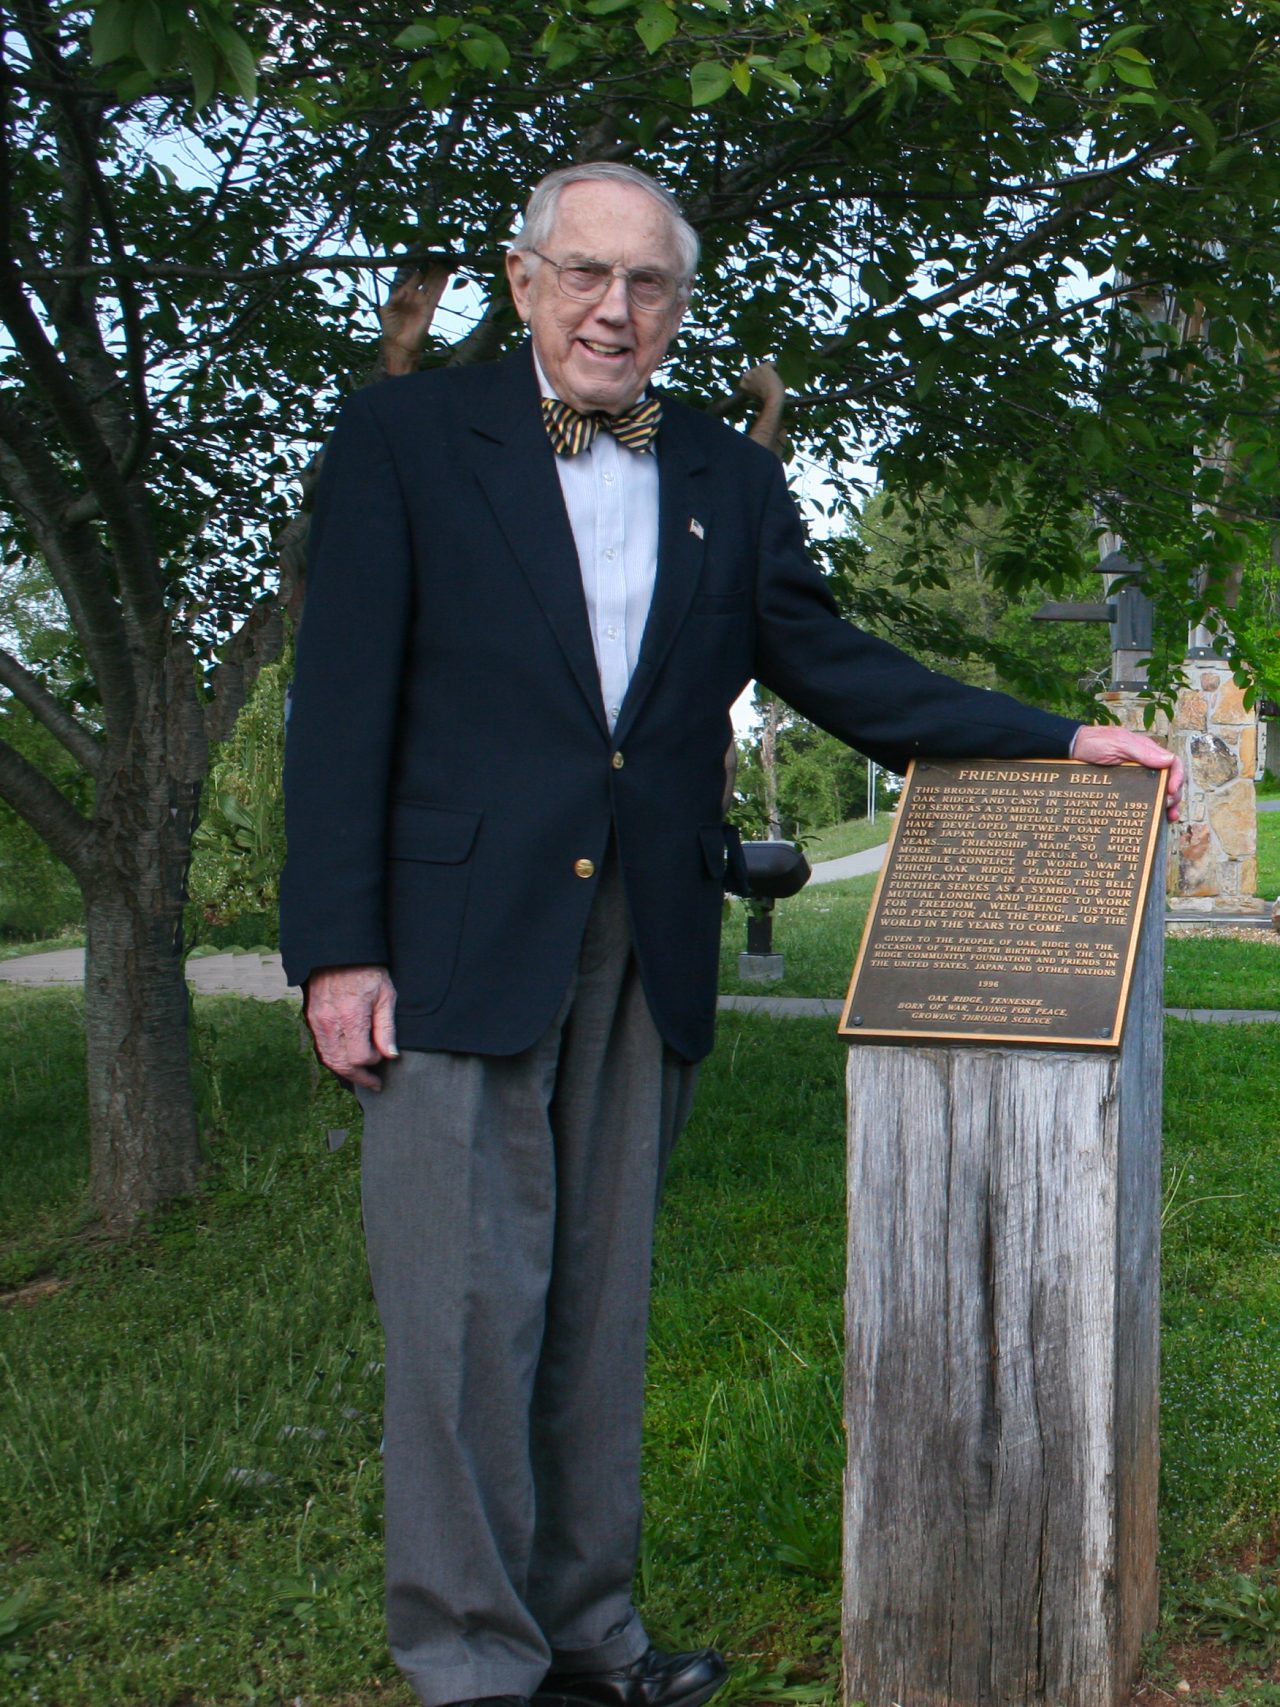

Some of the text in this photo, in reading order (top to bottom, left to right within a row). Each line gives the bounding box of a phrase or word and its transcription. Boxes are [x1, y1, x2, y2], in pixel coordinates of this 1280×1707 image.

[956, 768, 1113, 785] FRIENDSHIP BELL
[913, 785, 1120, 800] THIS BRONZE BELL WAS DESIGNED IN
[912, 793, 936, 801] OAK
[941, 794, 976, 803] RIDGE
[981, 796, 1005, 804] AND
[1009, 797, 1040, 805] CAST
[1045, 798, 1057, 806] IN
[1063, 799, 1098, 808] JAPAN
[1123, 801, 1148, 810] 1993
[928, 803, 963, 811] SERVE
[995, 805, 1041, 814] SYMBOL
[1089, 809, 1128, 817] BONDS
[907, 810, 1145, 827] FRIENDSHIP AND MUTUAL REGARD THAT
[905, 819, 1143, 835] HAVE DEVELOPED BETWEEN OAK RIDGE
[939, 829, 975, 837] JAPAN
[987, 831, 1019, 839] OVER
[1067, 834, 1096, 842] PAST
[1109, 836, 1142, 844] FIFTY
[898, 845, 931, 853] MORE
[941, 847, 1015, 856] MEANINGFUL
[961, 838, 1028, 848] FRIENDSHIP
[1037, 841, 1071, 850] MADE
[1080, 843, 1096, 851] SO
[1106, 844, 1140, 852] MUCH
[896, 854, 951, 863] TERRIBLE
[957, 856, 1015, 865] CONFLICT
[1021, 858, 1038, 866] OF
[1045, 859, 1088, 868] WORLD
[1095, 861, 1121, 869] WAR
[893, 862, 1136, 879] WHICH OAK RIDGE PLAYED SUCH A
[891, 871, 963, 881] SIGNIFICANT
[967, 874, 997, 882] ROLE
[1002, 875, 1016, 883] IN
[1073, 878, 1100, 886] THIS
[1105, 879, 1134, 888] BELL
[888, 880, 941, 889] FURTHER
[946, 883, 990, 891] SERVES
[995, 884, 1010, 892] AS
[1030, 886, 1079, 894] SYMBOL
[1107, 889, 1132, 897] OUR
[883, 898, 907, 906] FOR
[886, 889, 1131, 905] MUTUAL LONGING AND PLEDGE TO WORK
[881, 907, 1127, 924] AND PEACE FOR ALL THE PEOPLE OF THE
[878, 917, 1065, 932] WORLD IN THE YEARS TO COME.
[872, 942, 922, 951] OCCASION
[942, 945, 972, 953] THEIR
[975, 946, 1000, 954] 50TH
[1004, 947, 1052, 956] BIRTHDAY
[882, 934, 913, 942] GIVEN
[933, 936, 954, 944] THE
[957, 937, 994, 945] PEOPLE
[1015, 939, 1037, 947] OAK
[1040, 940, 1070, 948] RIDGE
[1093, 942, 1114, 950] THE
[872, 950, 902, 958] RIDGE
[906, 952, 965, 960] COMMUNITY
[969, 954, 1031, 963] FOUNDATION
[868, 959, 890, 967] THE
[892, 960, 929, 968] UNITED
[1010, 964, 1032, 972] AND
[1035, 965, 1070, 974] OTHER
[1072, 967, 1116, 976] NATIONS
[926, 994, 949, 1002] OAK
[989, 997, 1043, 1005] TENNESSEE
[895, 1002, 925, 1010] BORN
[928, 1003, 943, 1011] OF
[974, 1005, 1007, 1013] LIVING
[1010, 1006, 1031, 1014] FOR
[909, 1012, 1053, 1024] GROWING THROUGH SCIENCE
